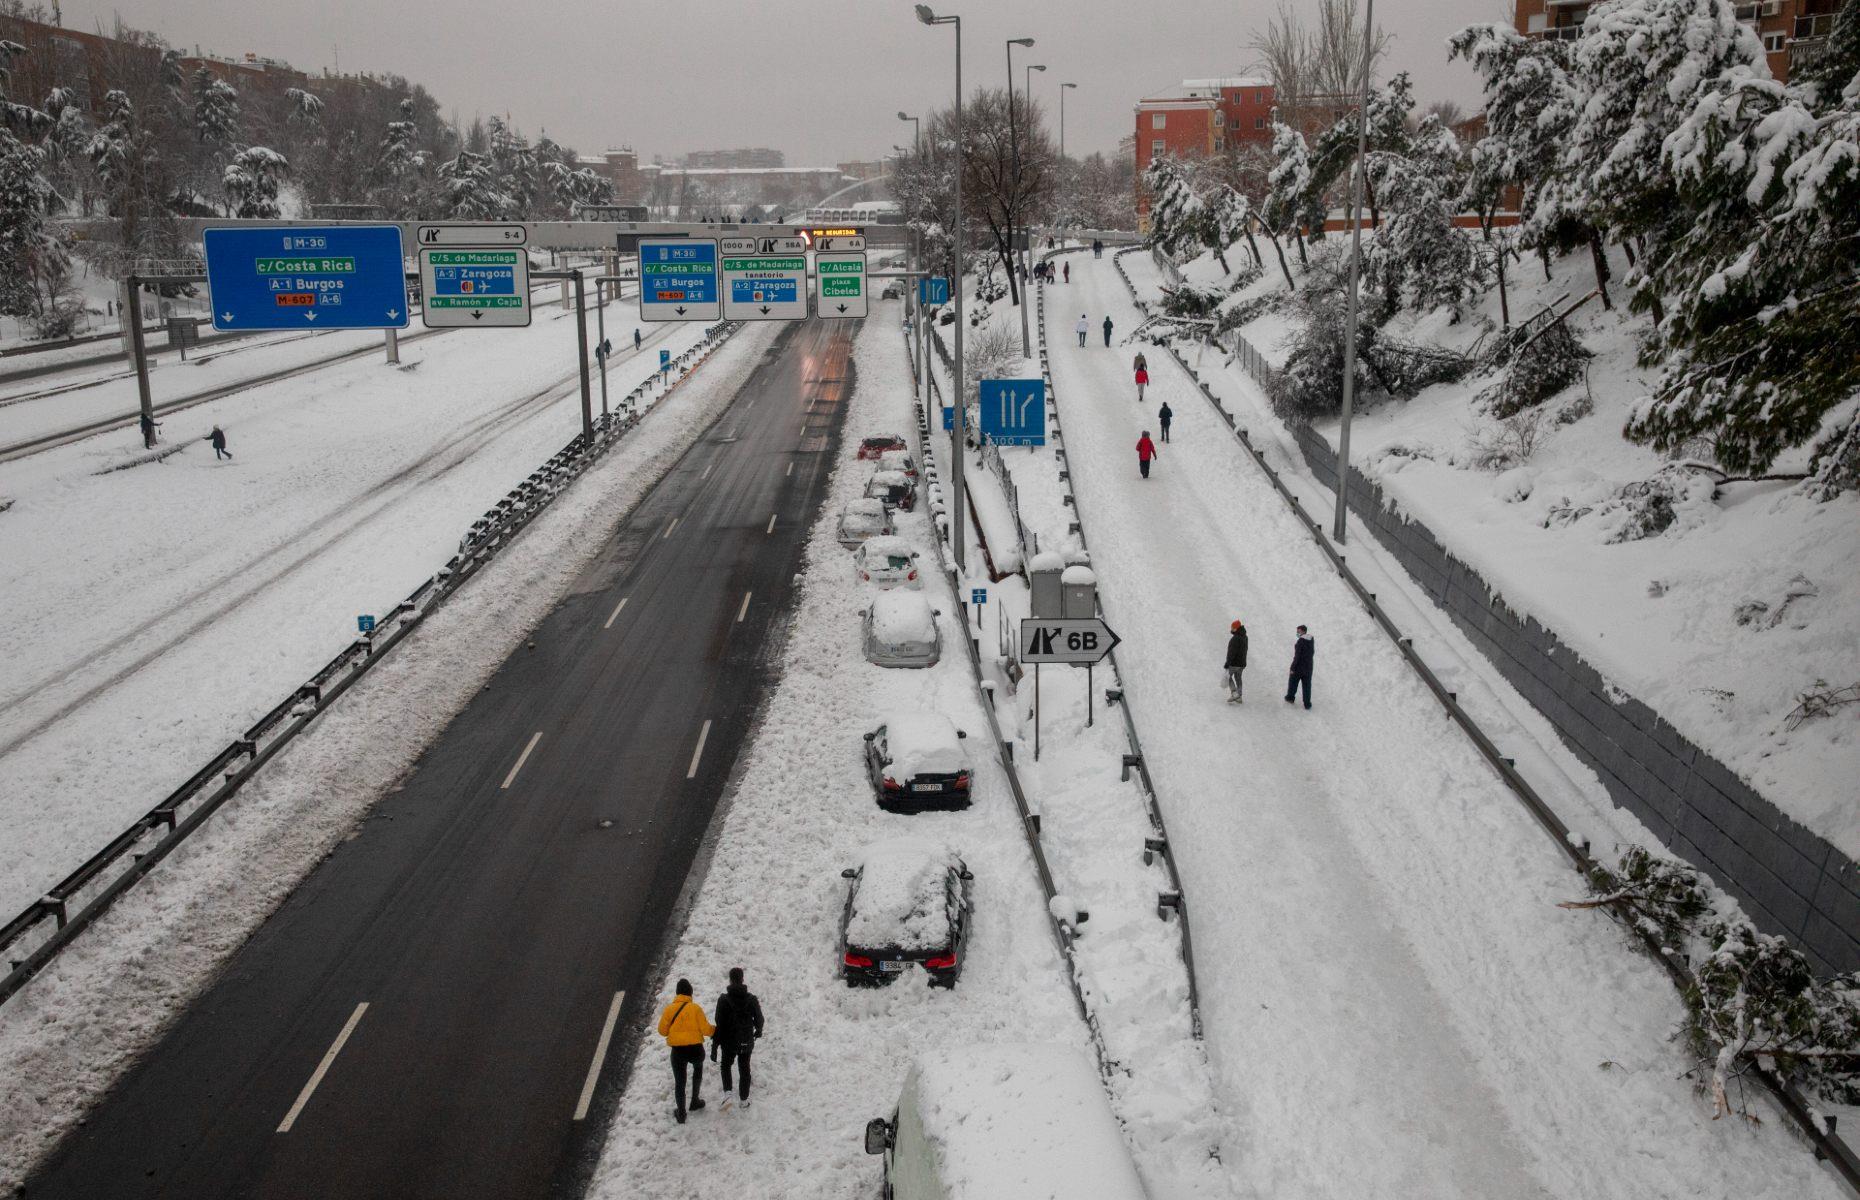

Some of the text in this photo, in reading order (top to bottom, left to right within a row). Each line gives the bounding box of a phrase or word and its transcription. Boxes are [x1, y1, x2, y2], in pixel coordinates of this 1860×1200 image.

[295, 238, 325, 248] M-30
[454, 254, 466, 262] de
[468, 254, 515, 263] Madariaga
[322, 260, 353, 271] Rica
[660, 264, 688, 273] Costa
[692, 264, 712, 272] Rica
[759, 260, 803, 269] Madariaga
[438, 269, 512, 279] A-2 Zaragoza
[745, 271, 784, 279] tanatorio
[271, 279, 344, 292] A-1 Burgos
[671, 278, 704, 288] Burgos
[753, 281, 796, 291] Zaragoza
[831, 278, 852, 287] plaza
[824, 286, 860, 296] Cibeles
[278, 295, 340, 305] M-607 A-6
[450, 298, 480, 306] Ramón
[497, 298, 520, 308] Cajal
[1067, 631, 1098, 651] 6B
